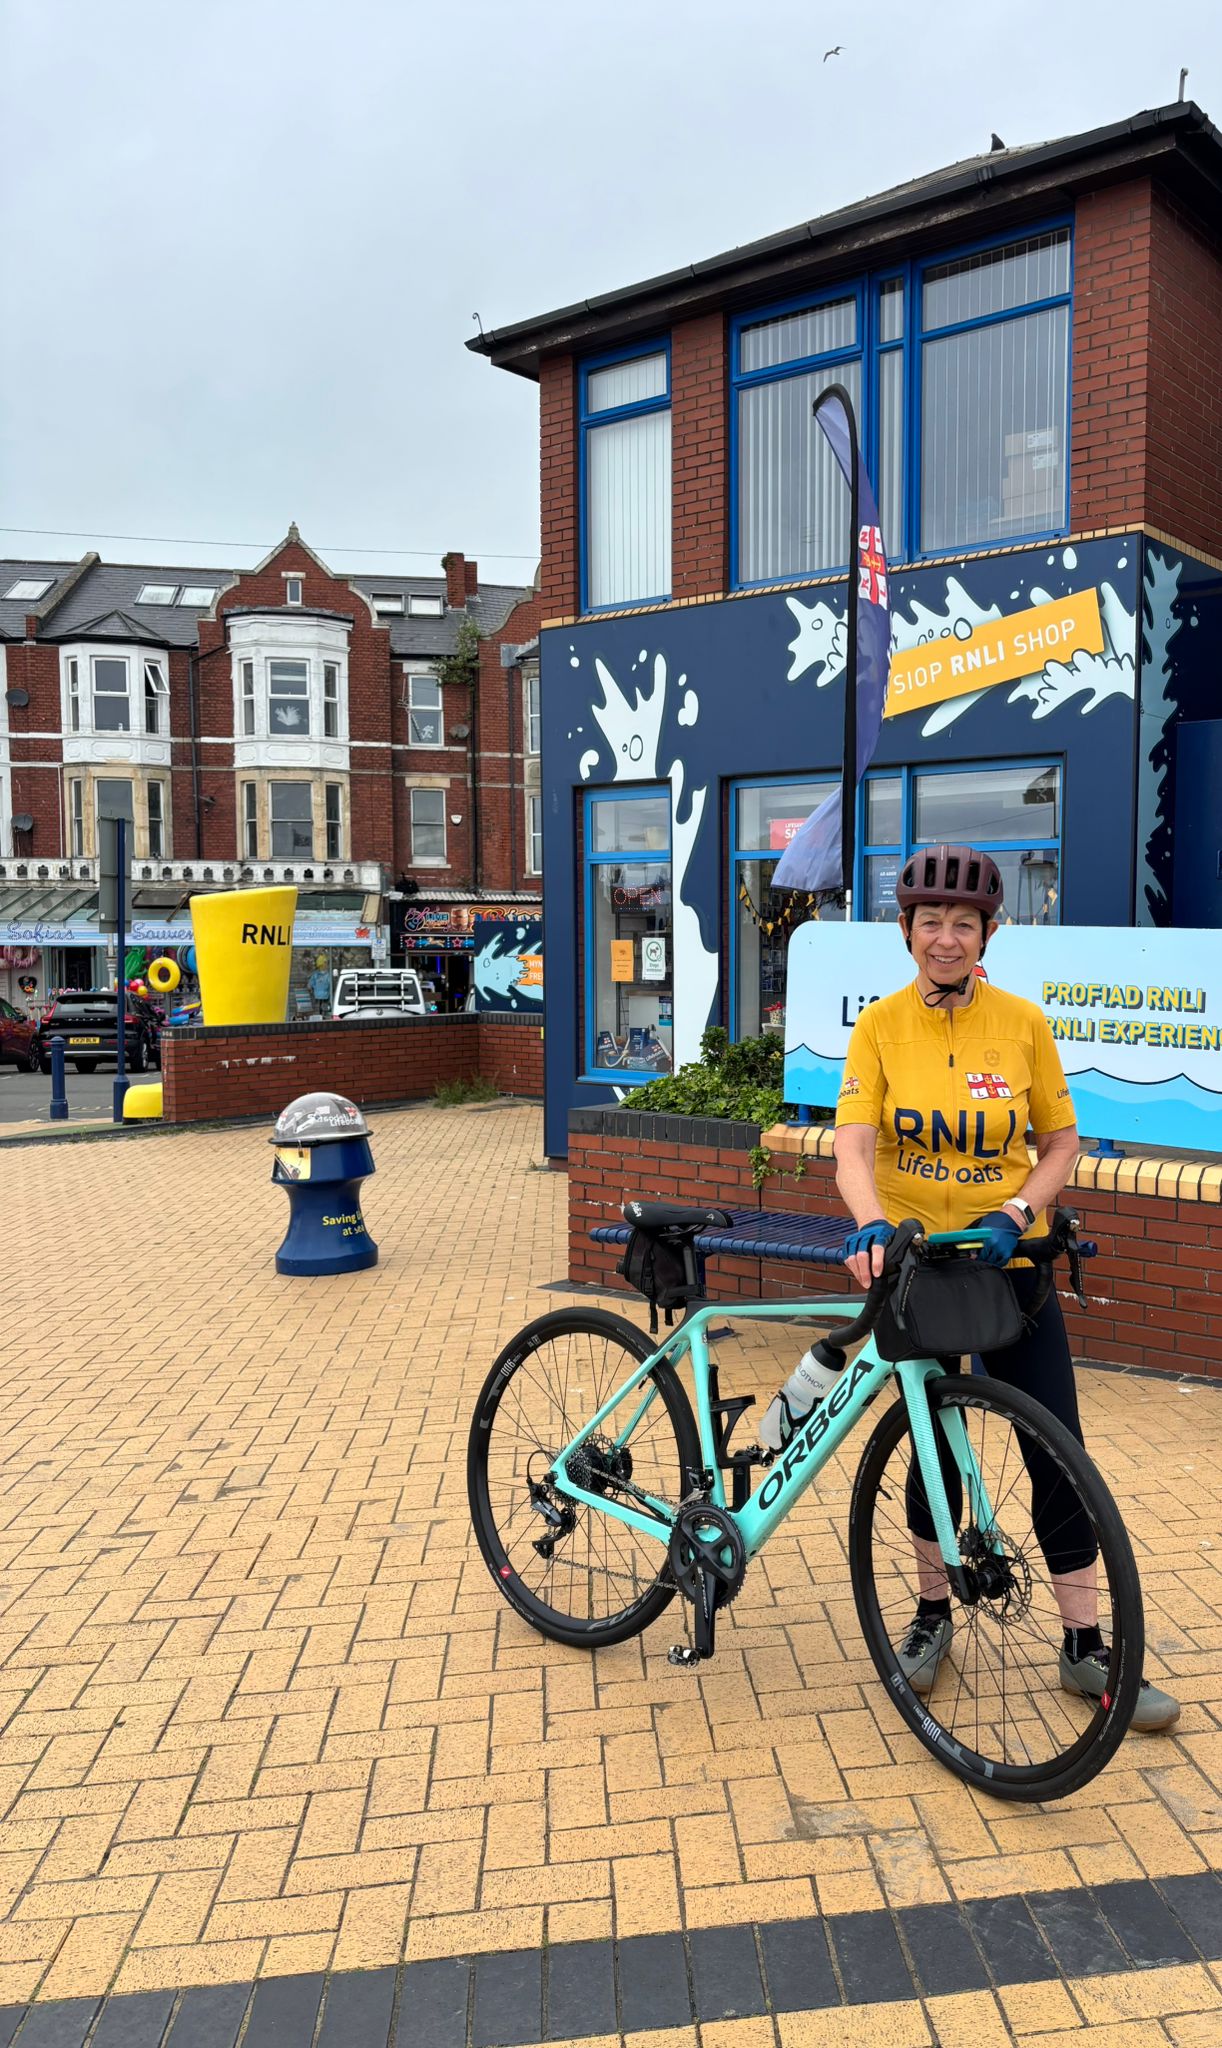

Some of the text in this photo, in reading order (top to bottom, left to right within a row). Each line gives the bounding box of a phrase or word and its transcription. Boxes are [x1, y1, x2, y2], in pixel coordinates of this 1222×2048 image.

[893, 618, 1076, 696] SIOP RNLI SHOP
[613, 886, 662, 905] OPEN
[241, 923, 291, 946] RNLI
[1042, 981, 1206, 1013] PROFIAD RNLI
[894, 1107, 1017, 1159] RNLI
[896, 1149, 1003, 1184] Lifeboats
[322, 1213, 357, 1226] Saving
[342, 1226, 353, 1237] at
[758, 1359, 875, 1510] ORBEA
[921, 1716, 942, 1742] 900
